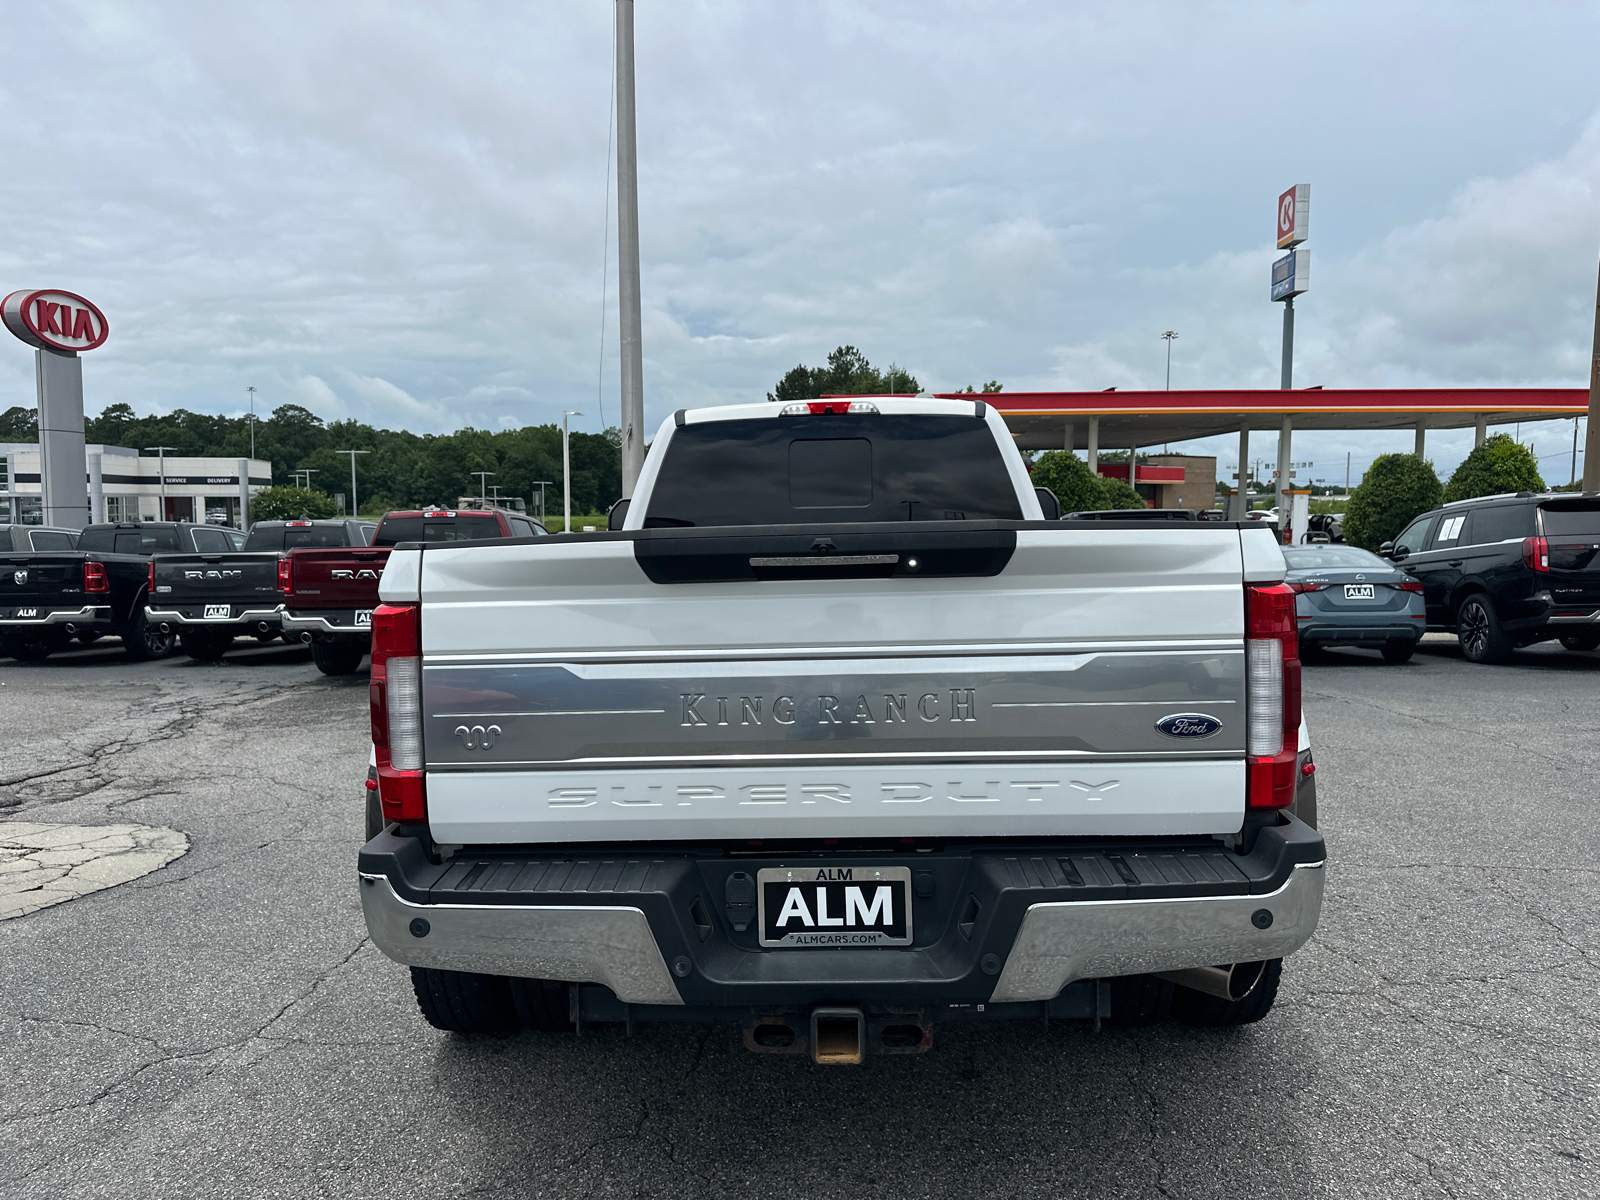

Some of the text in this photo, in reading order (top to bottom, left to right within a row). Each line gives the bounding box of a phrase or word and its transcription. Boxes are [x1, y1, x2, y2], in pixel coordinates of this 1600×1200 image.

[36, 299, 96, 342] KIA
[184, 570, 242, 579] RAM
[1348, 588, 1371, 596] ALM
[17, 609, 37, 617] ALM
[207, 607, 228, 616] ALM
[680, 688, 977, 726] KING RANCH
[1170, 717, 1208, 735] Ford
[548, 779, 1120, 808] SUPER DUTY
[816, 868, 853, 881] ALM
[775, 886, 893, 927] ALM
[796, 935, 877, 944] ALMCARS.COM
